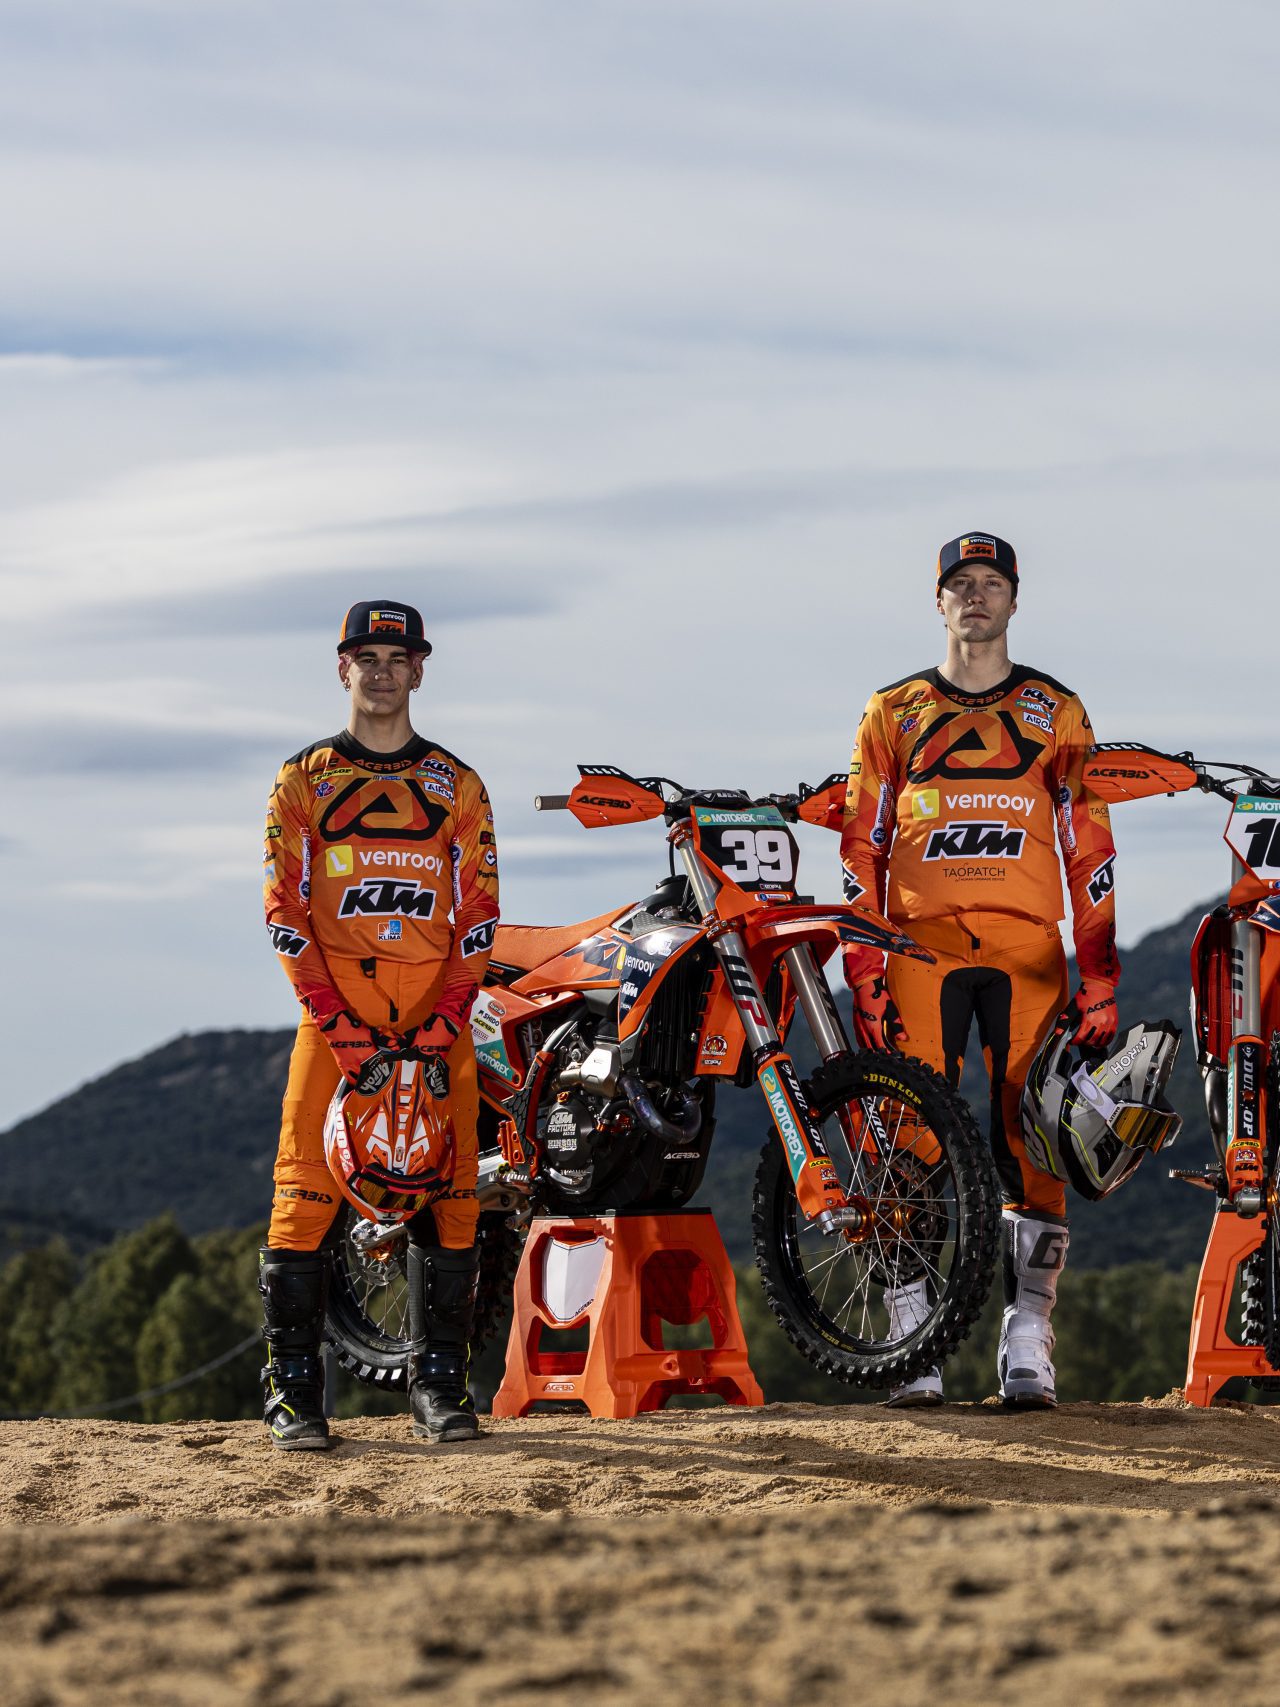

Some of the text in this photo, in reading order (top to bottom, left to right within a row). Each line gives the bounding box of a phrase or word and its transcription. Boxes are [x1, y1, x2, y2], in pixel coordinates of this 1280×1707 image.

[965, 546, 992, 556] KTM
[381, 613, 405, 622] venrooy
[1021, 688, 1058, 712] KTM
[421, 758, 457, 780] KTM
[1087, 767, 1149, 779] ACERBIS
[576, 795, 632, 809] ACERBIS
[945, 793, 1036, 817] venrooy
[710, 813, 756, 822] MOTOREX
[922, 820, 1027, 862] KTM
[359, 850, 443, 877] venrooy
[721, 829, 794, 883] 39
[943, 867, 1006, 877] TAOPATCH
[338, 877, 437, 920] KTM
[624, 954, 655, 977] venrooy
[621, 981, 639, 998] KTM
[473, 1017, 496, 1034] ACERBIS
[483, 1013, 500, 1027] SHIDO
[330, 1040, 373, 1049] ACERBIS
[475, 1048, 509, 1076] MOTOREX
[1110, 1037, 1149, 1075] AIROH
[868, 1072, 922, 1105] DUNLOP
[550, 1112, 573, 1124] KTM
[769, 1090, 805, 1161] MOTOREX
[548, 1123, 577, 1133] FACTORY
[1234, 1163, 1259, 1172] KTM
[279, 1188, 334, 1204] ACERBIS
